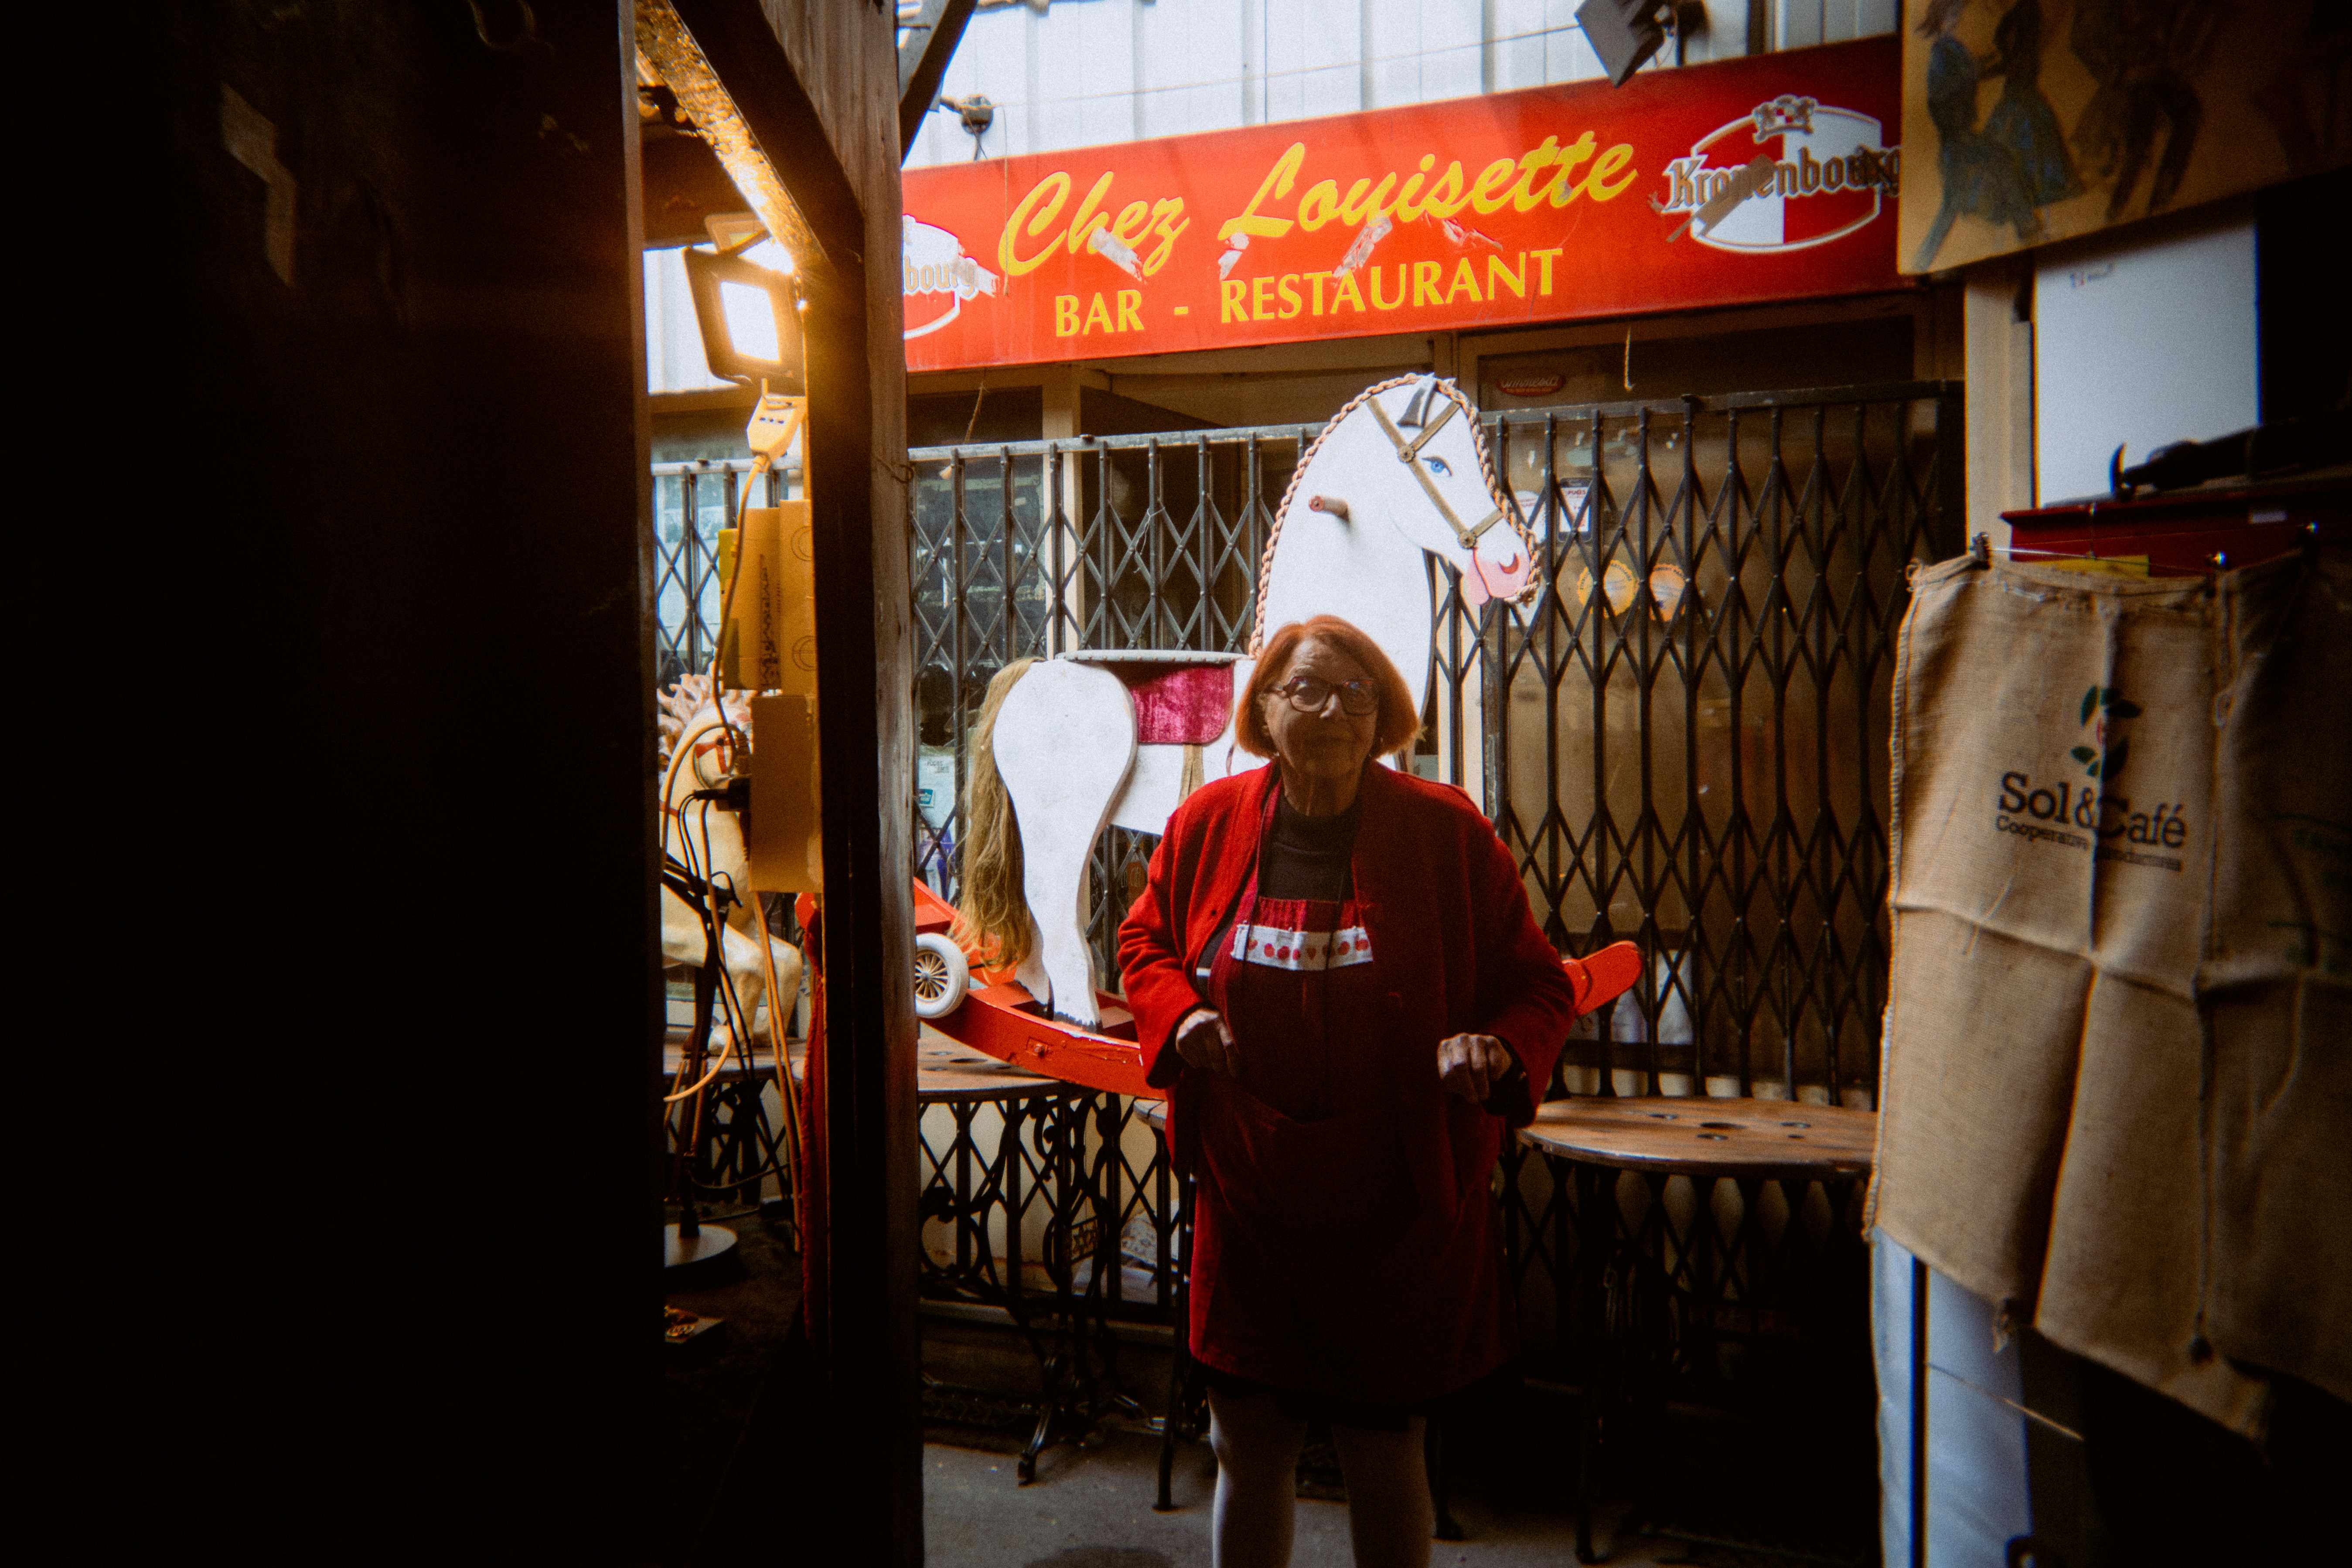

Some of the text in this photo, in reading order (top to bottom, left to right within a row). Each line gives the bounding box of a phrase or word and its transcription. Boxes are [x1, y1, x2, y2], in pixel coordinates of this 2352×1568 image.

[998, 131, 1638, 276] Chez Louisette
[1056, 248, 1563, 337] BAR - RESTAURANT
